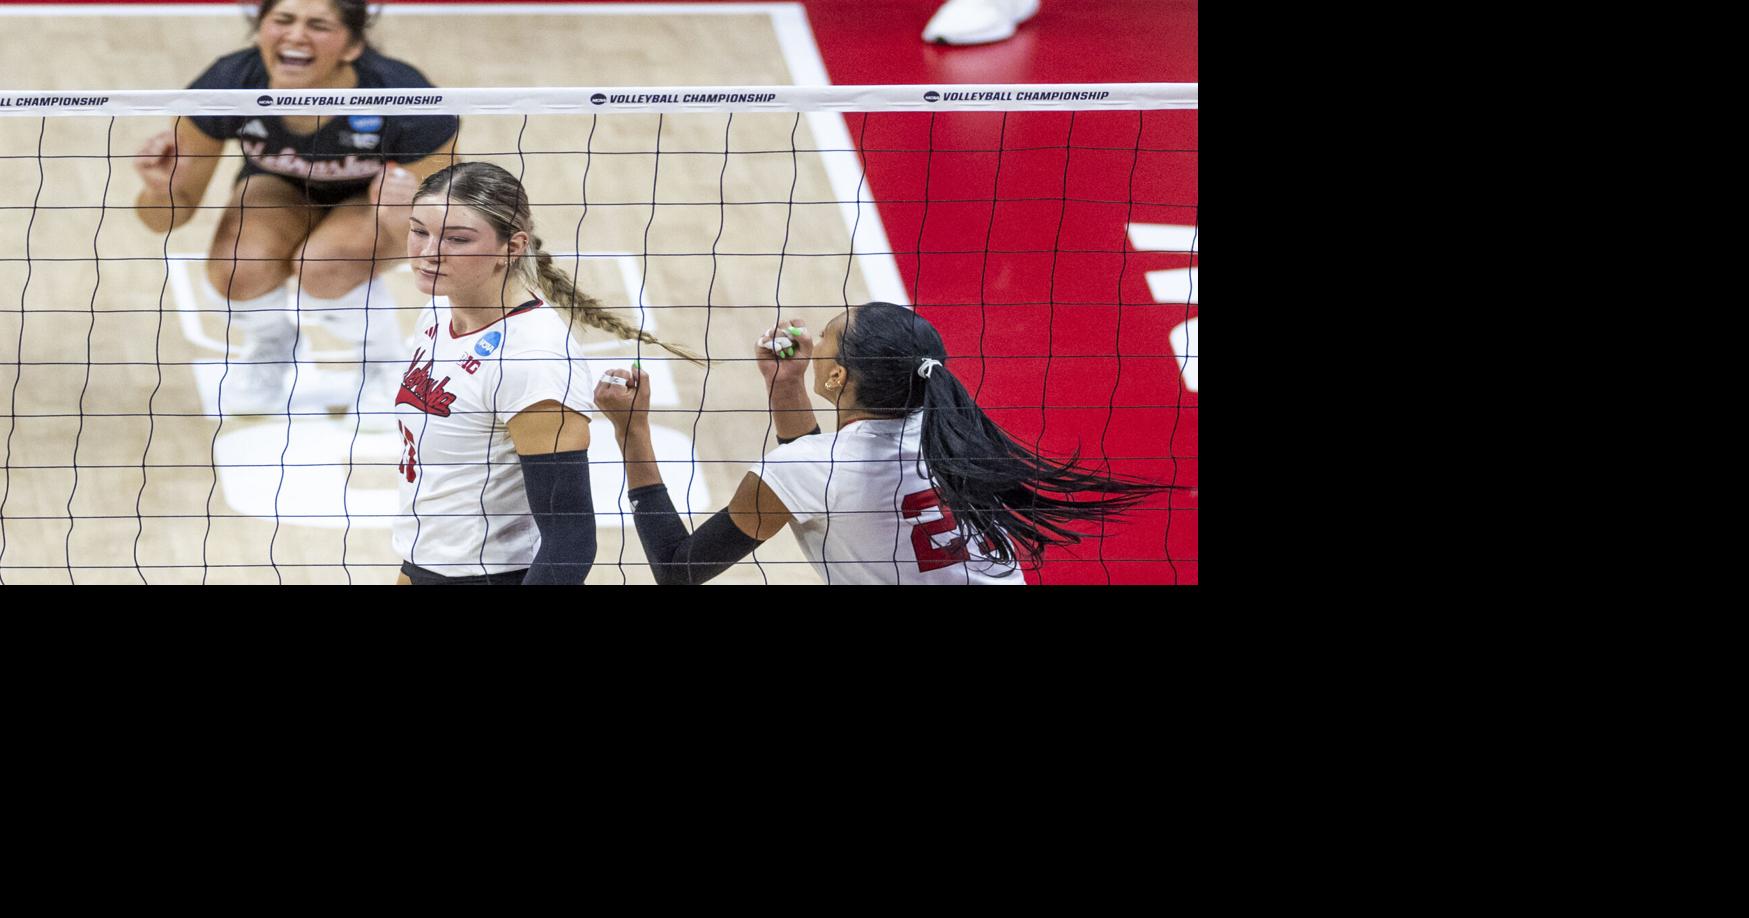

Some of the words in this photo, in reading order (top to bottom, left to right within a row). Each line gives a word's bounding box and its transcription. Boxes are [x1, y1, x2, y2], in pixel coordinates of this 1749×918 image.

[15, 96, 109, 106] CHAMPIONSHIP
[276, 96, 346, 106] VOLLEYBALL
[349, 95, 443, 105] CHAMPIONSHIP
[609, 94, 680, 104] VOLLEYBALL
[683, 93, 776, 103] CHAMPIONSHIP
[943, 91, 1013, 101] VOLLEYBALL
[1016, 91, 1109, 101] CHAMPIONSHIP
